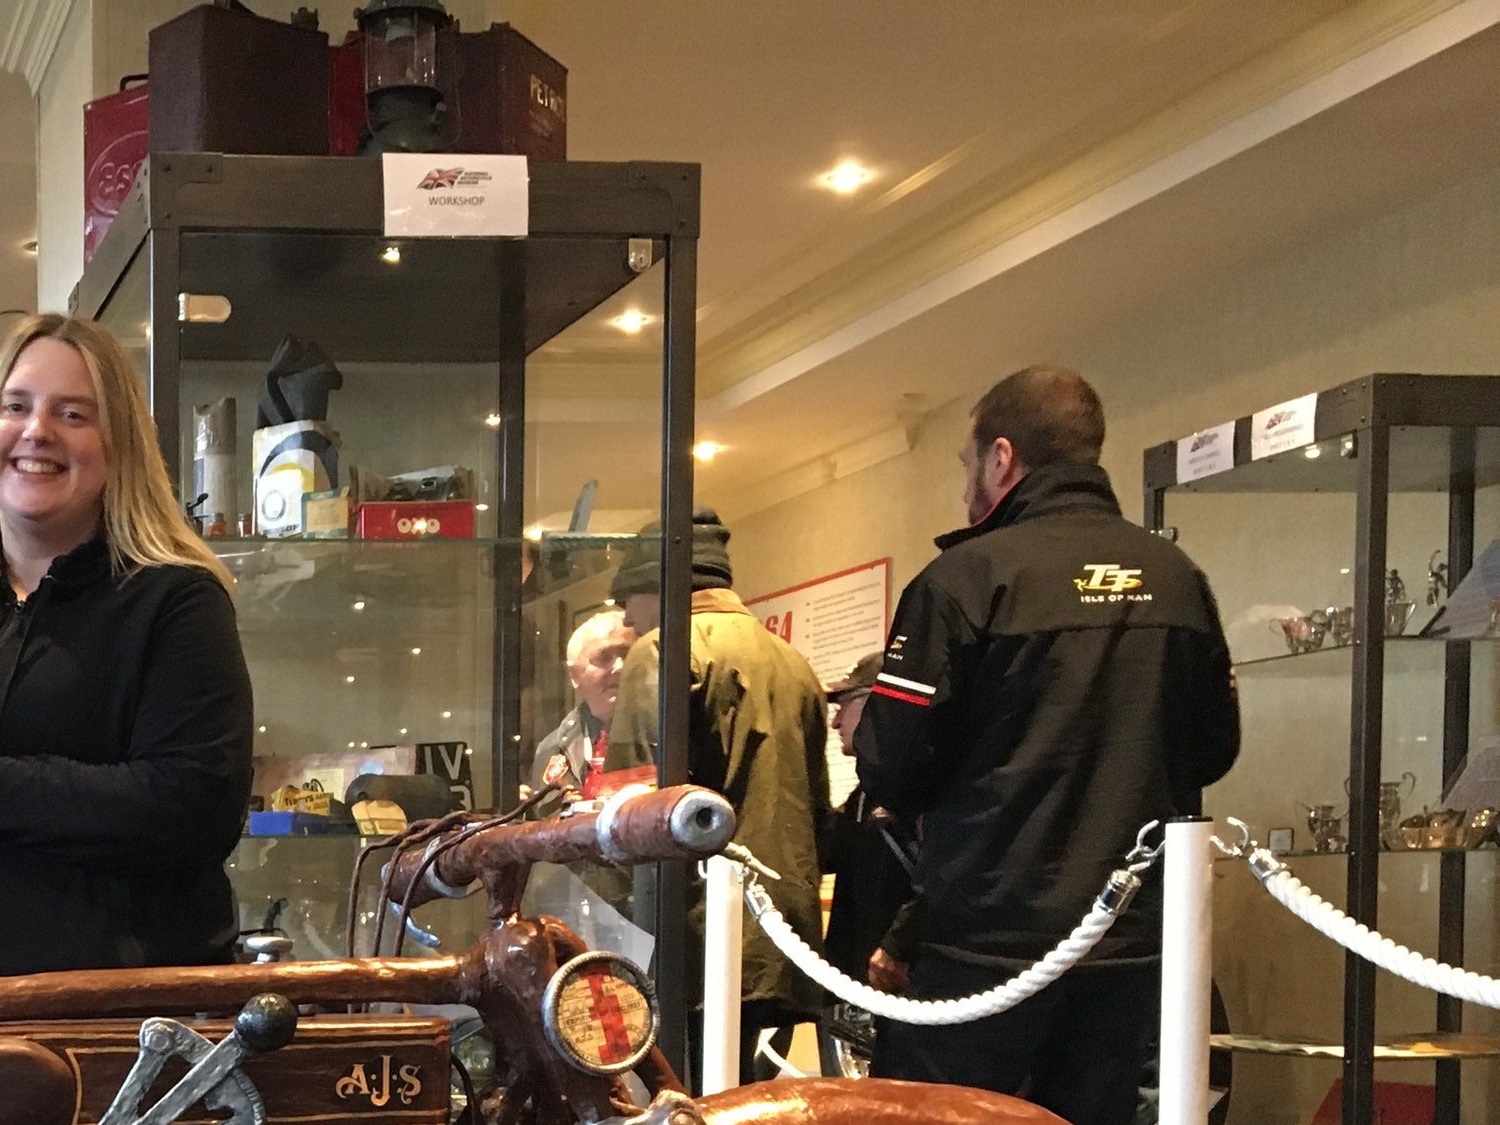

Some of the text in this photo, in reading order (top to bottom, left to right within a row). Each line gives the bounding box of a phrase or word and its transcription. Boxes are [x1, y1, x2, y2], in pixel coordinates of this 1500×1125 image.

[428, 196, 485, 206] WORKSHOP
[397, 517, 440, 534] OXO
[1080, 595, 1105, 603] ISLE
[1127, 594, 1153, 603] MAN
